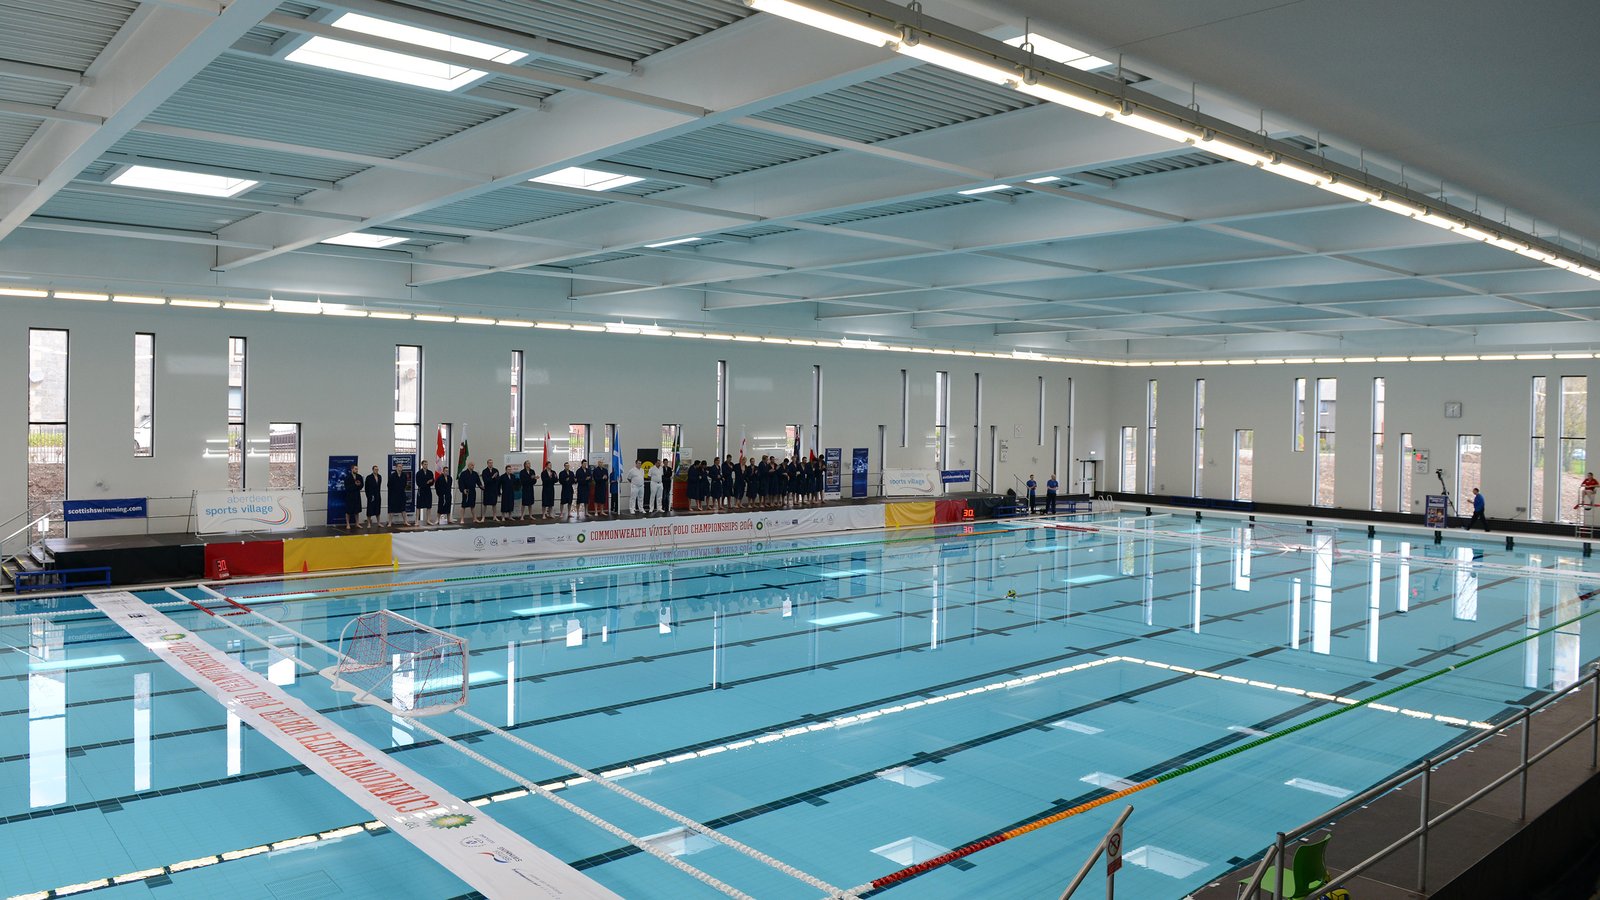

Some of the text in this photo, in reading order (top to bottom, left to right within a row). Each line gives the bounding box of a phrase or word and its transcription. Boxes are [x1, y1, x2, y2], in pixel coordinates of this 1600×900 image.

[227, 494, 272, 503] aberdeen
[67, 506, 143, 515] scottishswimming.com
[205, 504, 273, 517] sports village
[963, 509, 974, 517] 30
[590, 527, 647, 541] COMMONWEALTH
[673, 524, 689, 535] POLO
[691, 521, 739, 534] CHAMPIONSHIPS
[217, 559, 228, 571] 30
[258, 707, 322, 737] WATER
[296, 732, 439, 813] COMMONWEALTH
